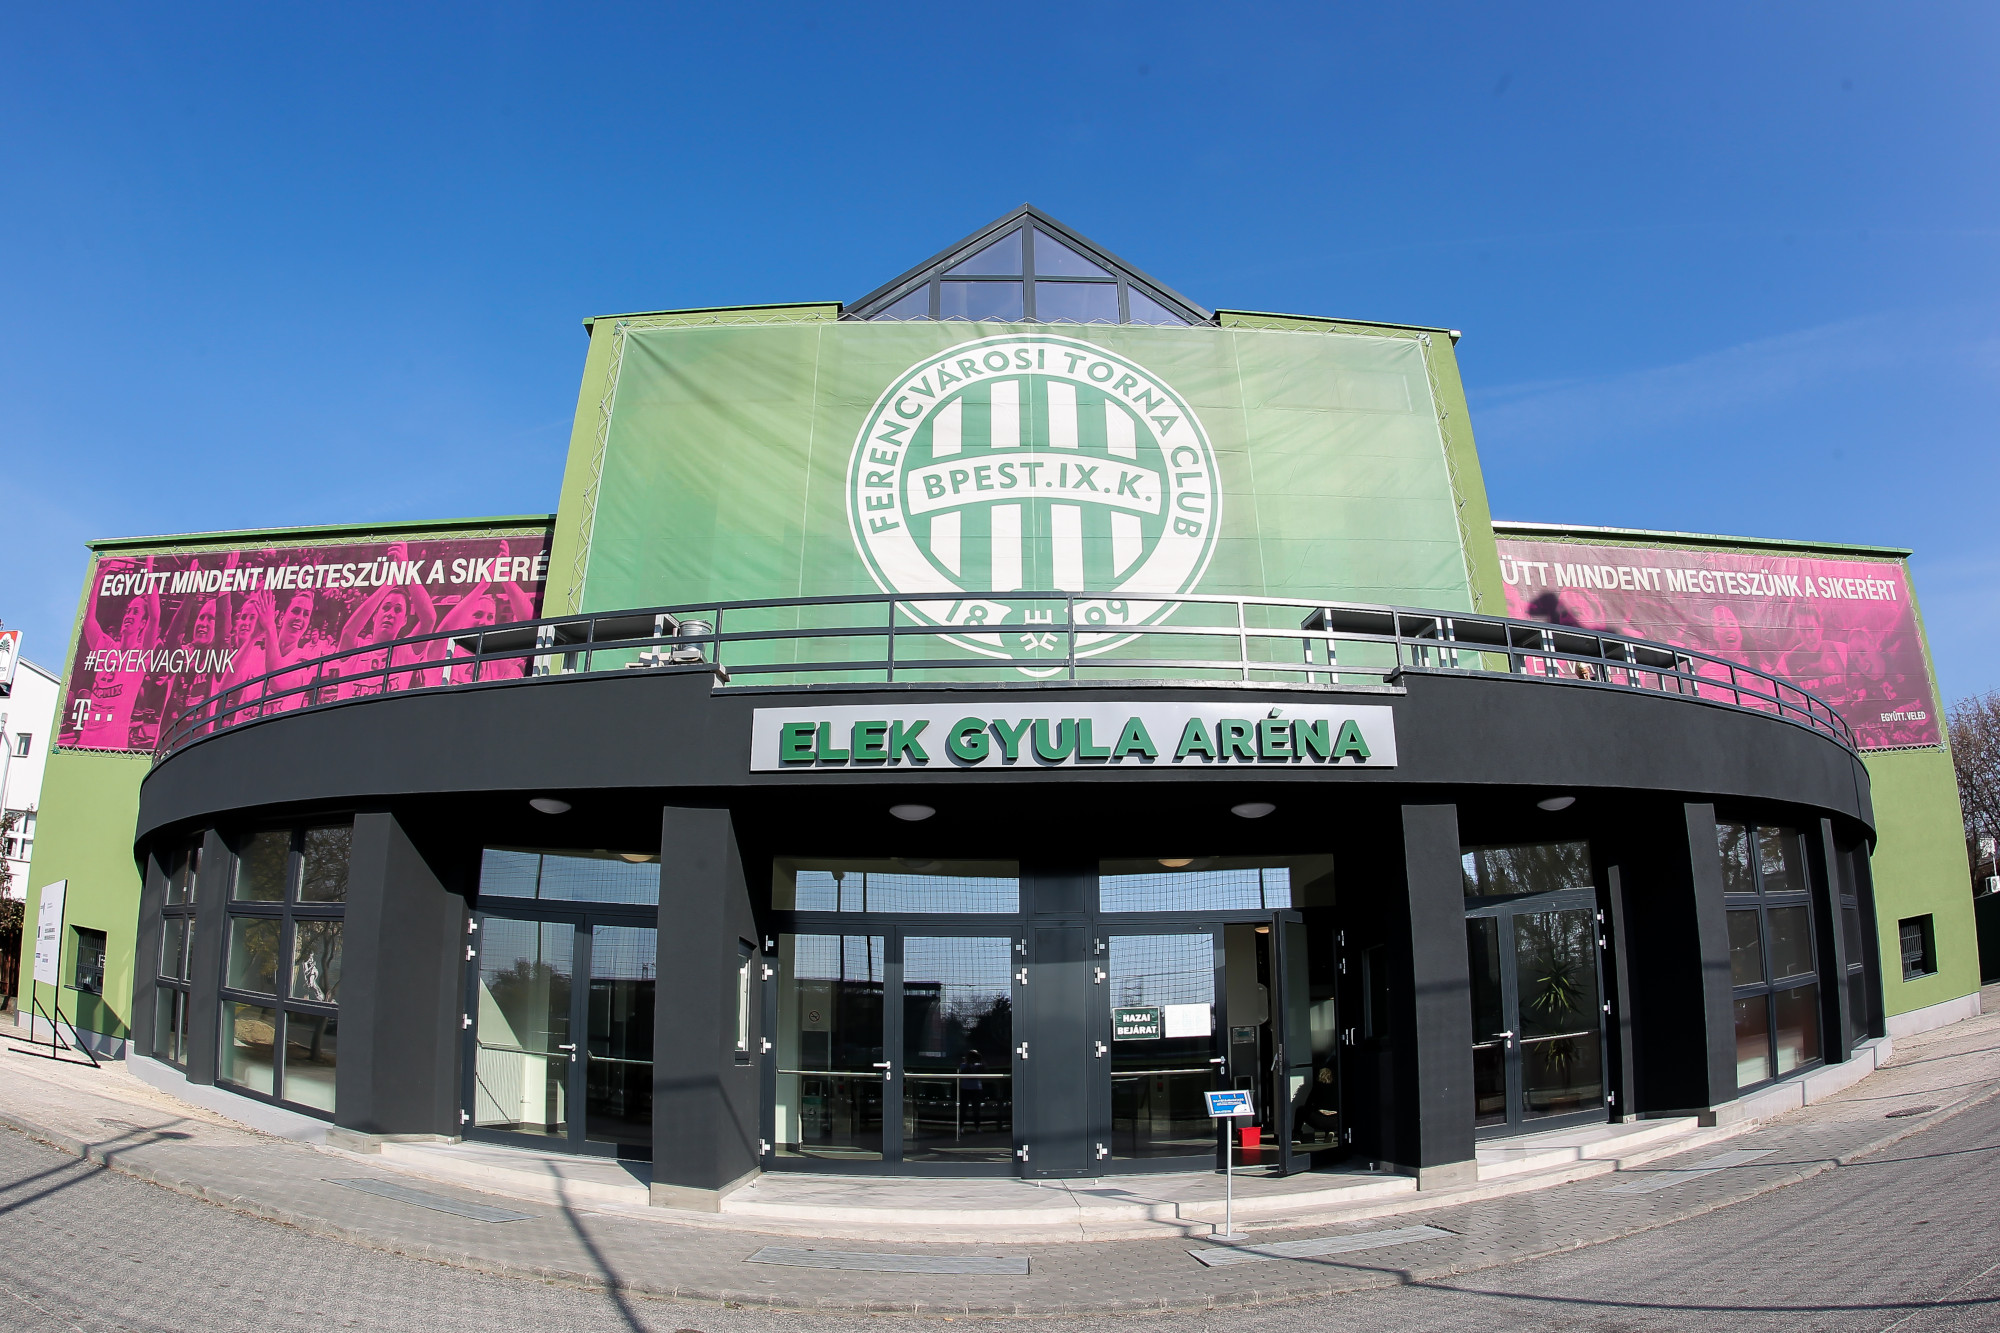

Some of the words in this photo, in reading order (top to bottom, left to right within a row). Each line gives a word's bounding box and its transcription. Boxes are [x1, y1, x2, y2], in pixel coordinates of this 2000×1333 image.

[866, 348, 1045, 534] FERENCVÁROSI
[1063, 351, 1179, 437] TORNA
[1170, 445, 1205, 538] CLUB
[100, 568, 170, 597] EGYÜTT
[170, 567, 263, 594] MINDENT
[264, 557, 425, 591] MEGTESZÜNK
[426, 559, 445, 585] A
[1553, 563, 1662, 591] MINDENT
[1666, 568, 1804, 597] MEGTESZÜNK
[1805, 575, 1819, 598] A
[1818, 574, 1897, 601] SIKERÉRT
[84, 648, 238, 673] #EGYEKVAGYUNK
[780, 719, 931, 764] ELEK
[946, 716, 1159, 764] GYULA
[1174, 707, 1372, 761] ARÉNA
[1117, 1024, 1157, 1036] BEJÁRAT
[1122, 1013, 1151, 1023] HAZAI
